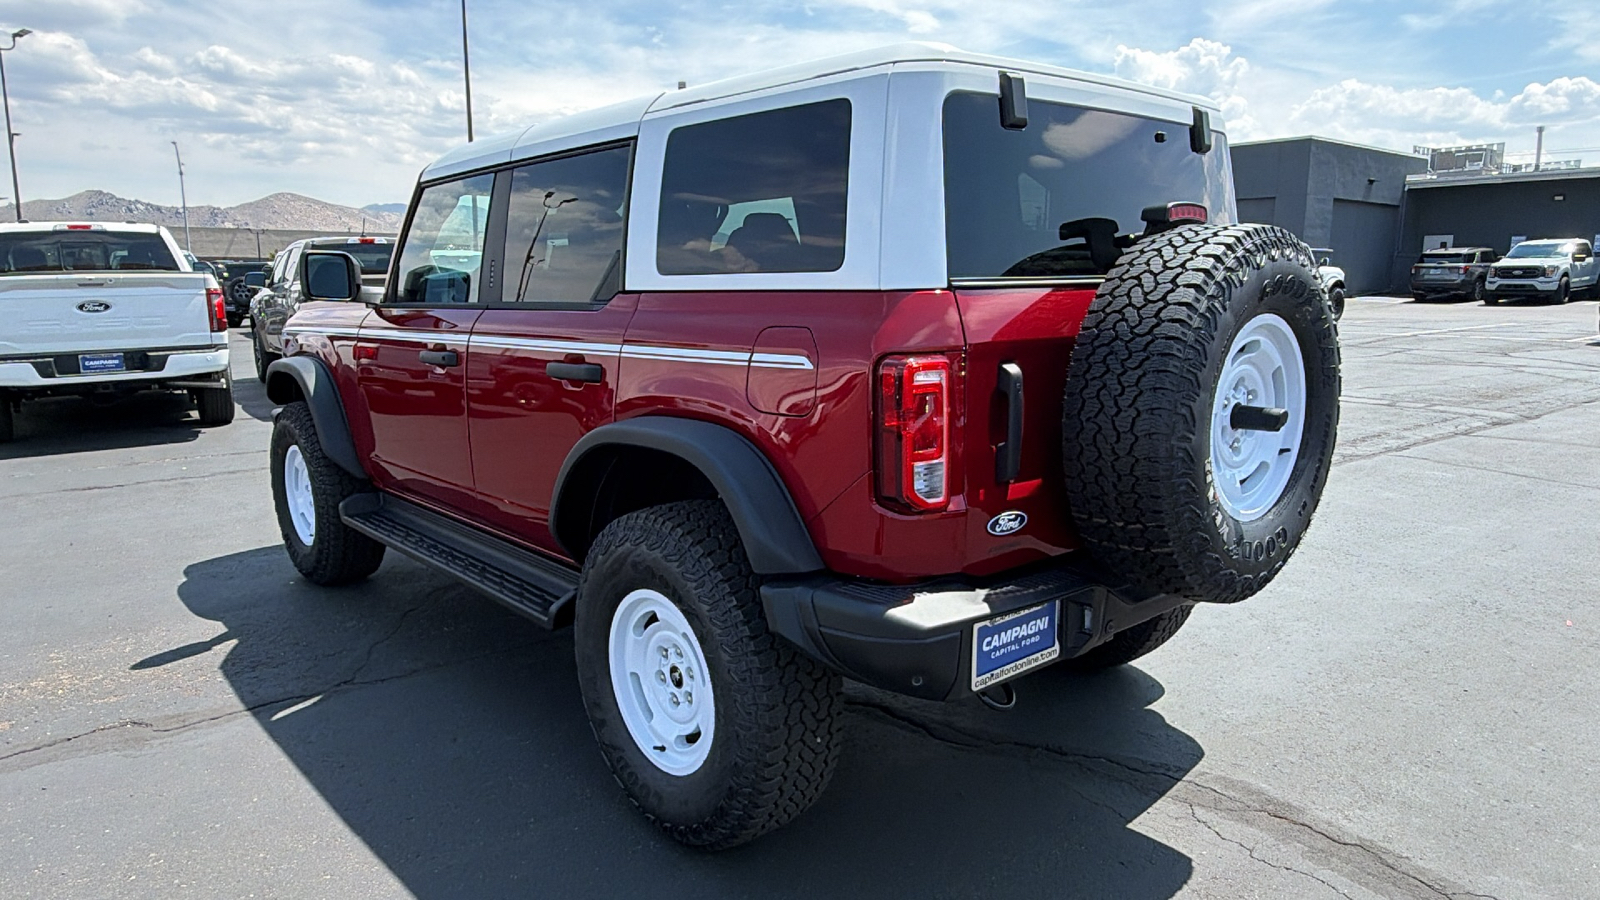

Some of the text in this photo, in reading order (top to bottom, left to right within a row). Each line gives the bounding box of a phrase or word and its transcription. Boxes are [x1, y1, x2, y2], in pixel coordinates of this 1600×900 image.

[81, 301, 107, 312] Ford
[994, 513, 1022, 533] Ford
[982, 616, 1049, 652] CAMPAGNI
[990, 634, 1041, 660] CAPITAL FORD
[974, 648, 1058, 688] capitalfordonline.com
